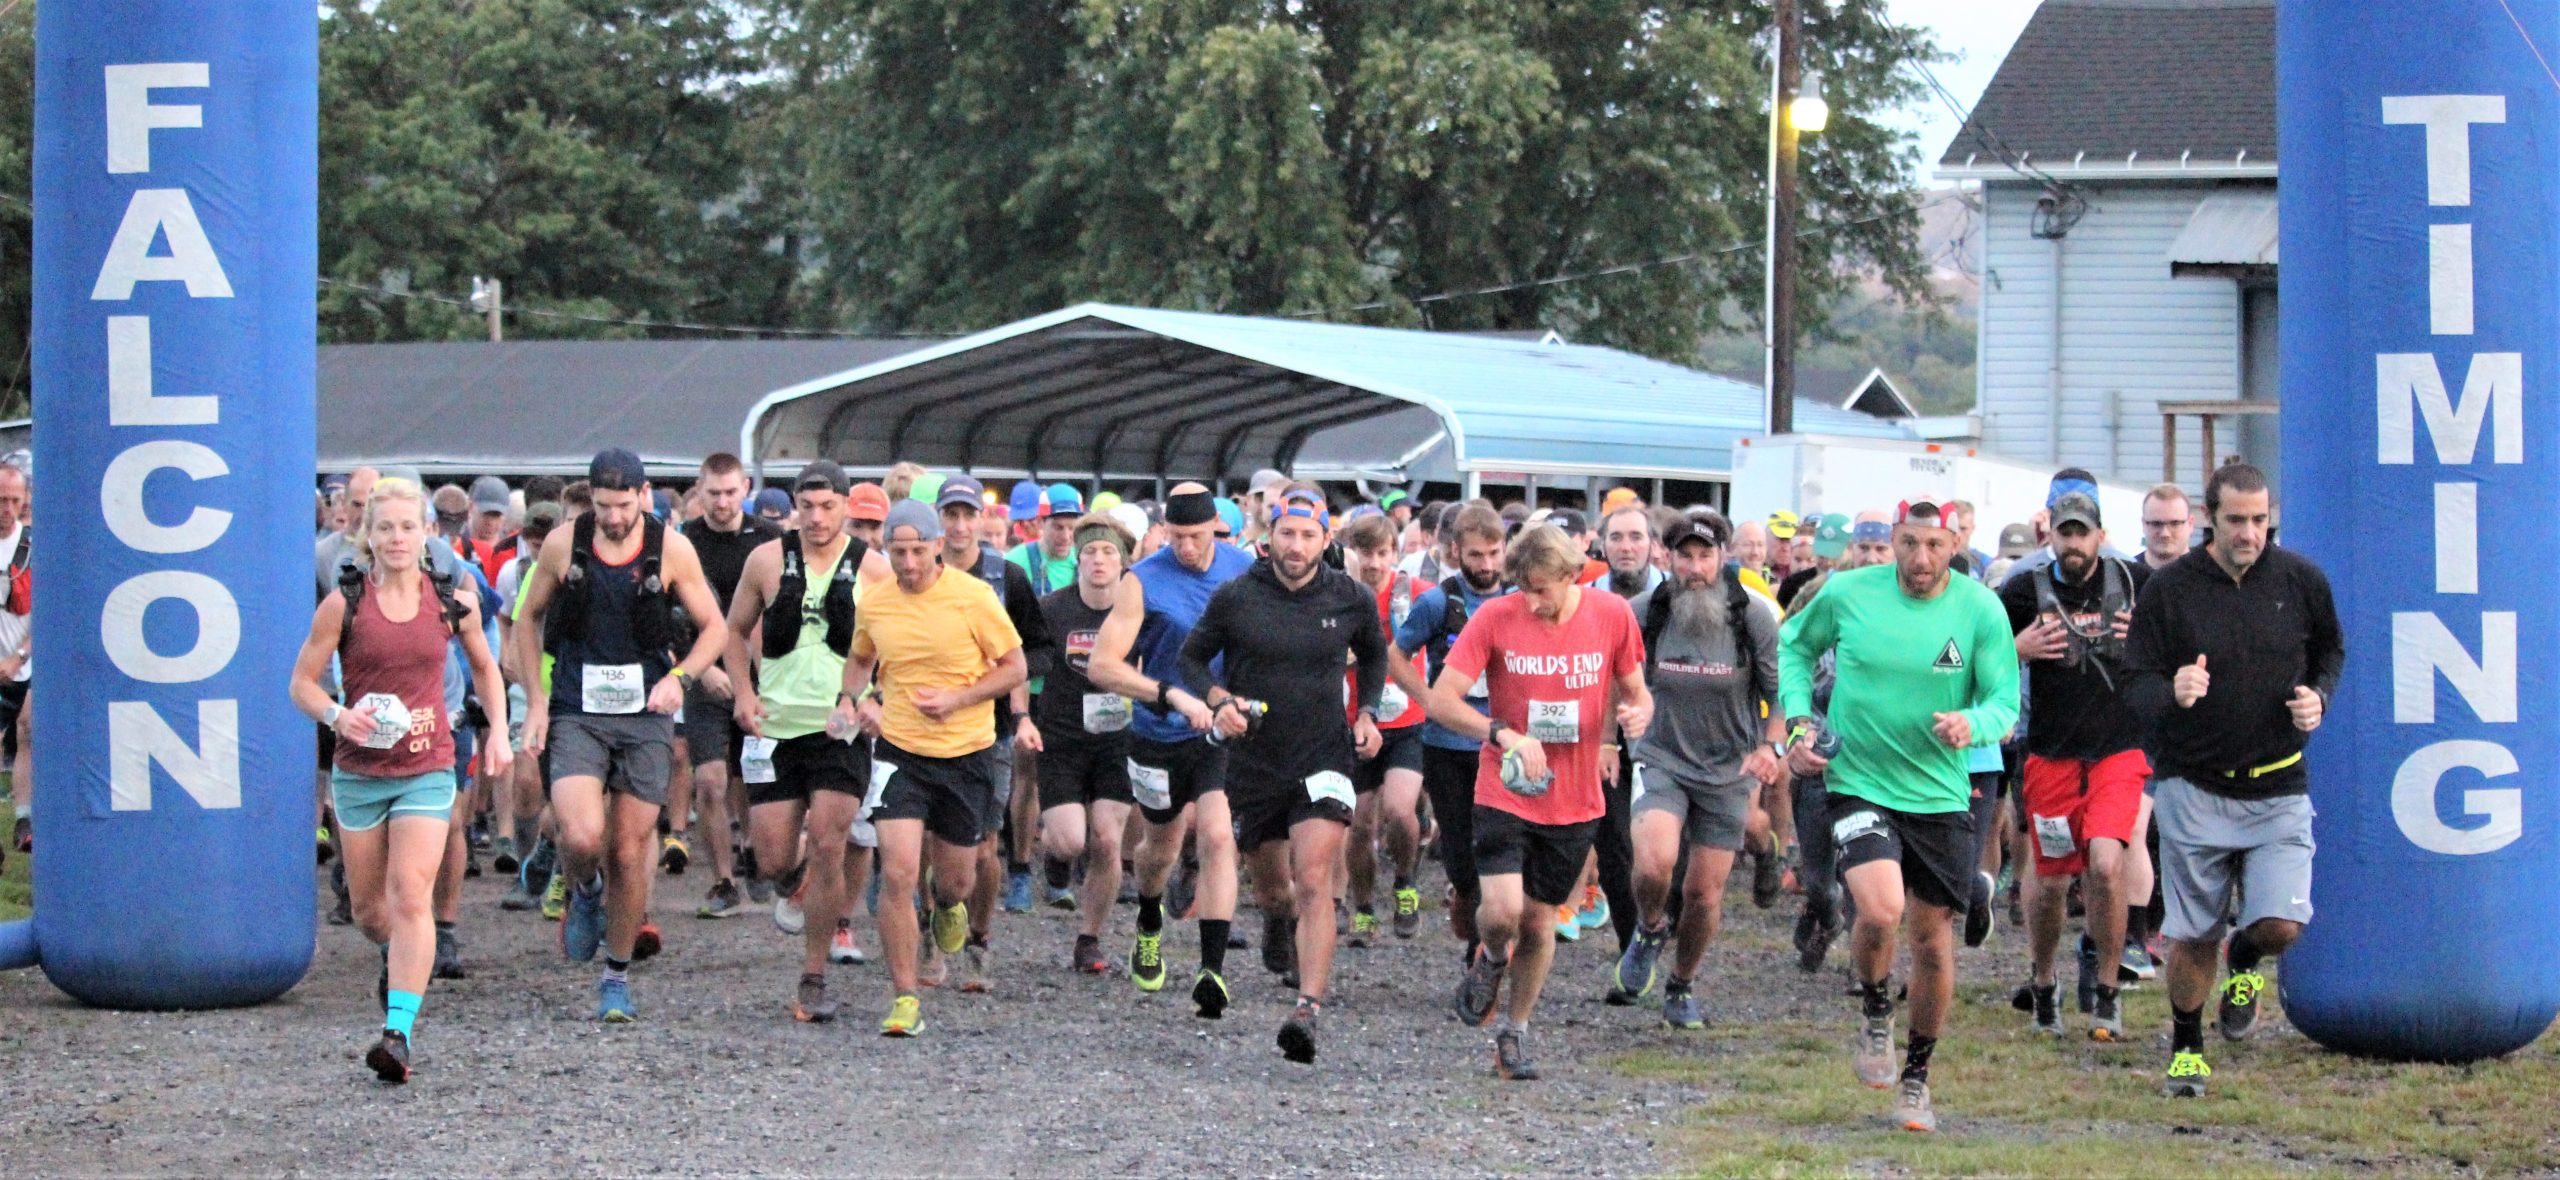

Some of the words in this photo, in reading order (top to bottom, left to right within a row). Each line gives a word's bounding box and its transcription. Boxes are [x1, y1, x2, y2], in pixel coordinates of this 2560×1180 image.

[91, 62, 241, 811] FALCON
[2376, 94, 2523, 855] TIMING
[1504, 655, 1569, 676] WORLDS
[1573, 652, 1604, 675] END
[1658, 661, 1701, 675] BOULDER
[1702, 665, 1734, 676] BEAST
[601, 669, 626, 681] 436
[1564, 673, 1599, 690] ULTRA
[368, 697, 391, 711] 129
[1540, 704, 1567, 717] 392
[410, 706, 437, 723] sal
[410, 719, 435, 736] om
[408, 738, 431, 754] on
